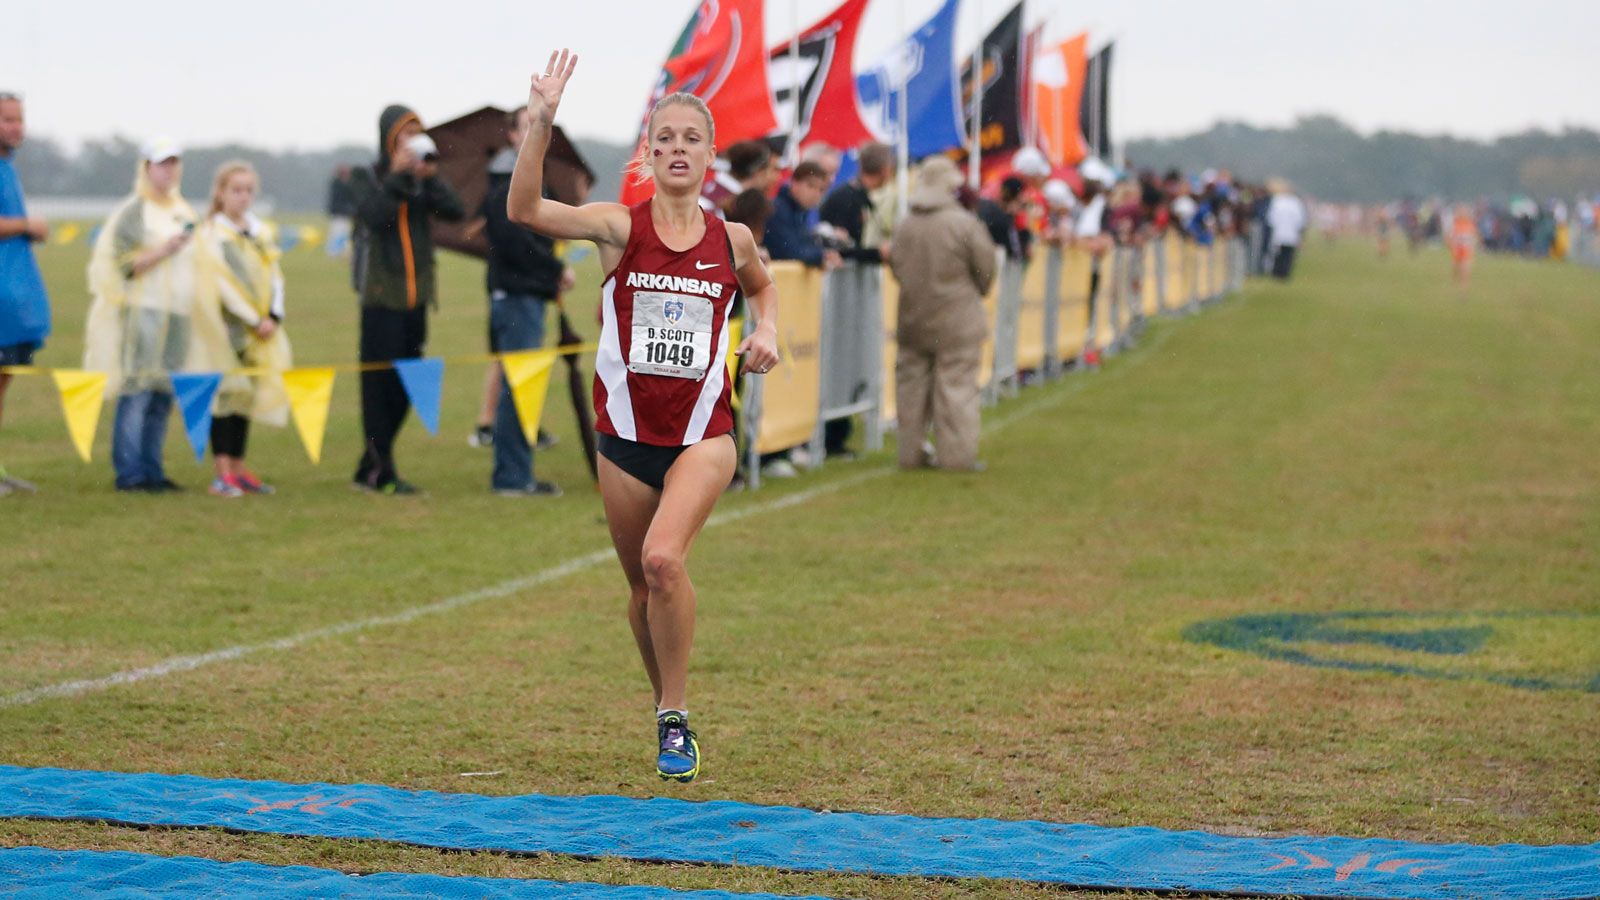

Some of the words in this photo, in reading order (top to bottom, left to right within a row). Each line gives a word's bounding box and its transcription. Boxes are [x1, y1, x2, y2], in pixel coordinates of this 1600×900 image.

[626, 272, 722, 298] ARKANSAS
[648, 327, 658, 340] D.
[660, 328, 695, 343] SCOTT
[645, 342, 694, 367] 1049
